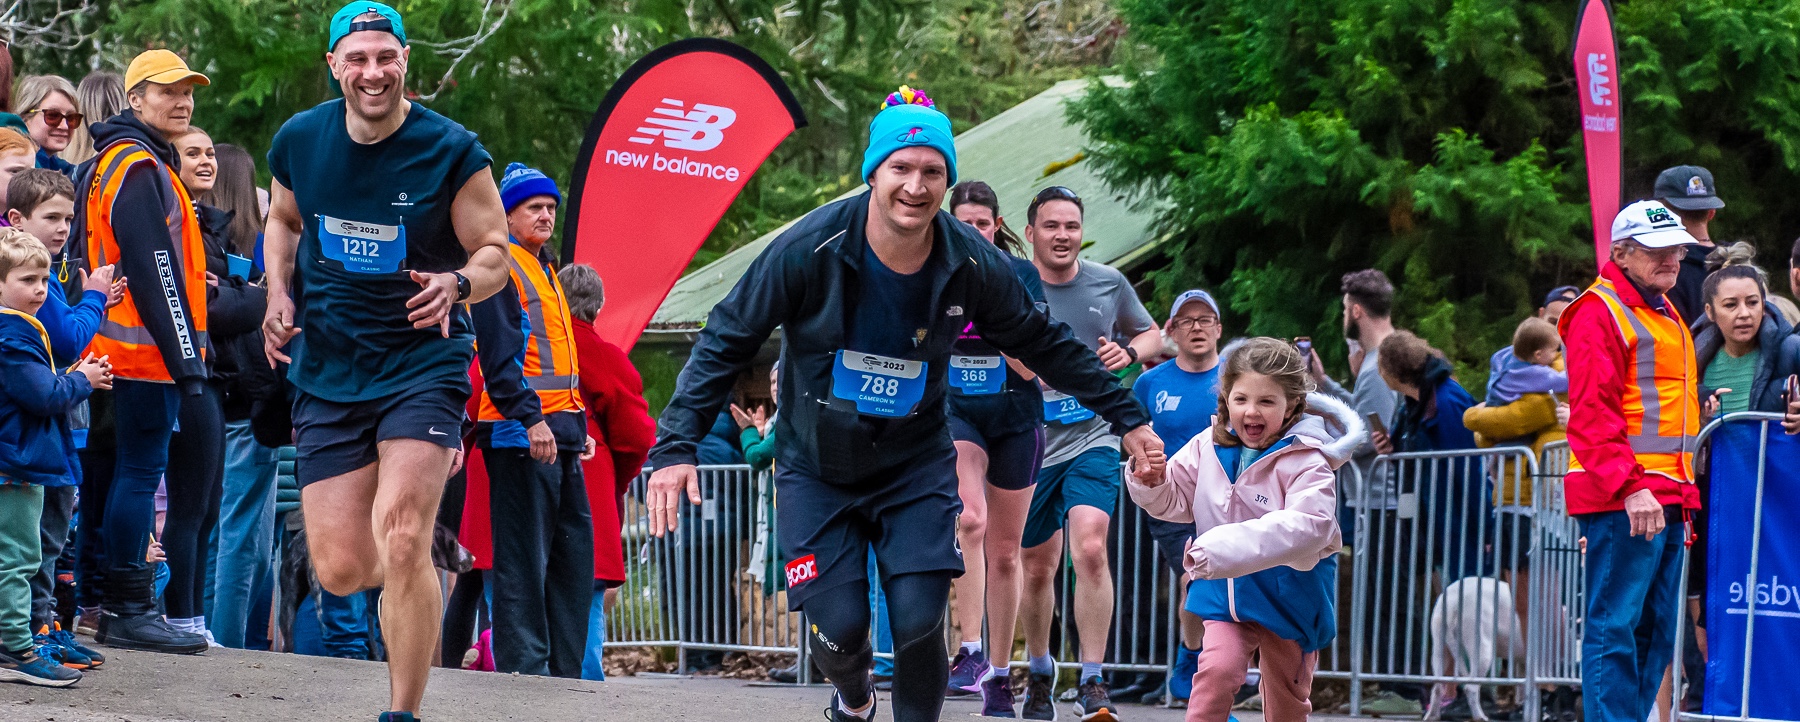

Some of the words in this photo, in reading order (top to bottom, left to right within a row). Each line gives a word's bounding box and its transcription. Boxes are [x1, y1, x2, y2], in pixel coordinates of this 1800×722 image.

[628, 98, 737, 152] NB
[605, 149, 649, 169] new
[652, 152, 740, 182] balance
[360, 226, 379, 234] 2023
[342, 237, 379, 257] 1212
[883, 361, 905, 371] 2023
[961, 369, 987, 382] 368
[860, 374, 899, 397] 788
[858, 394, 889, 404] CAMERON
